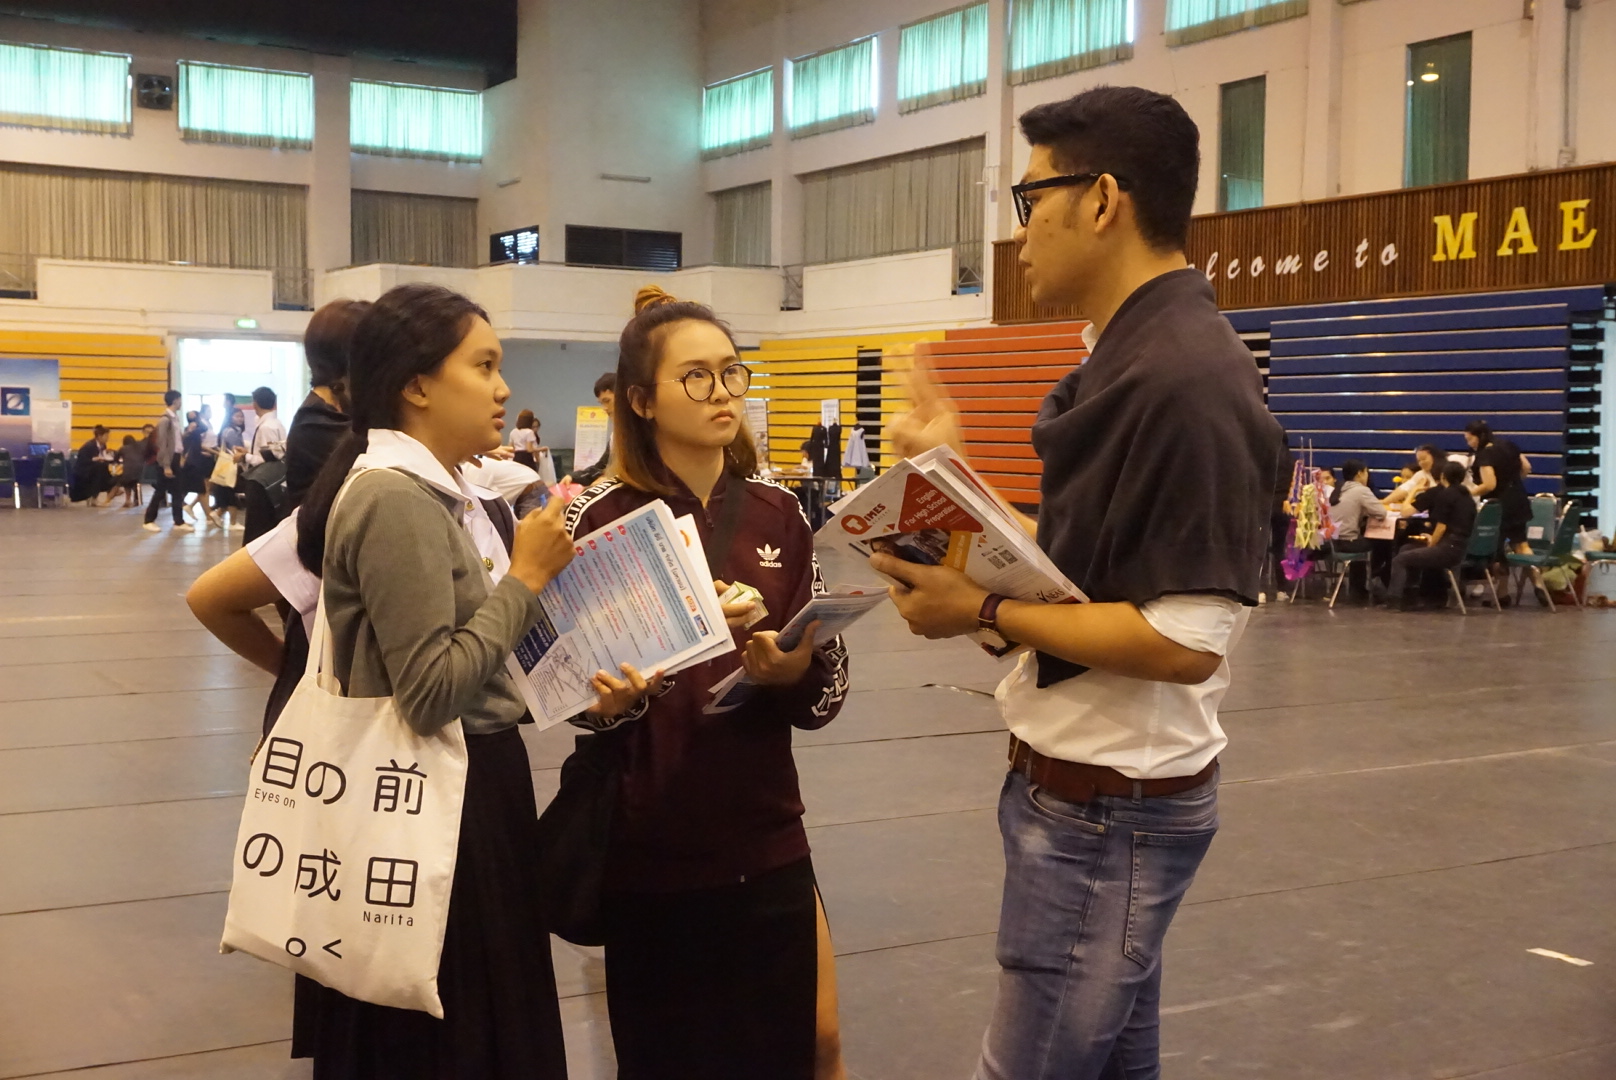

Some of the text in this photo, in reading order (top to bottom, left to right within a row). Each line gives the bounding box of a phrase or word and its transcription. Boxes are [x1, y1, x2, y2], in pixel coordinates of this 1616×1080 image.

[1187, 199, 1598, 281] lcome to MAE
[915, 489, 938, 504] English
[565, 495, 592, 531] WITH
[904, 495, 948, 527] For High School
[924, 504, 957, 526] Preparation
[759, 560, 782, 568] adidas
[254, 788, 296, 809] Eyes on
[363, 910, 414, 927] Narita
